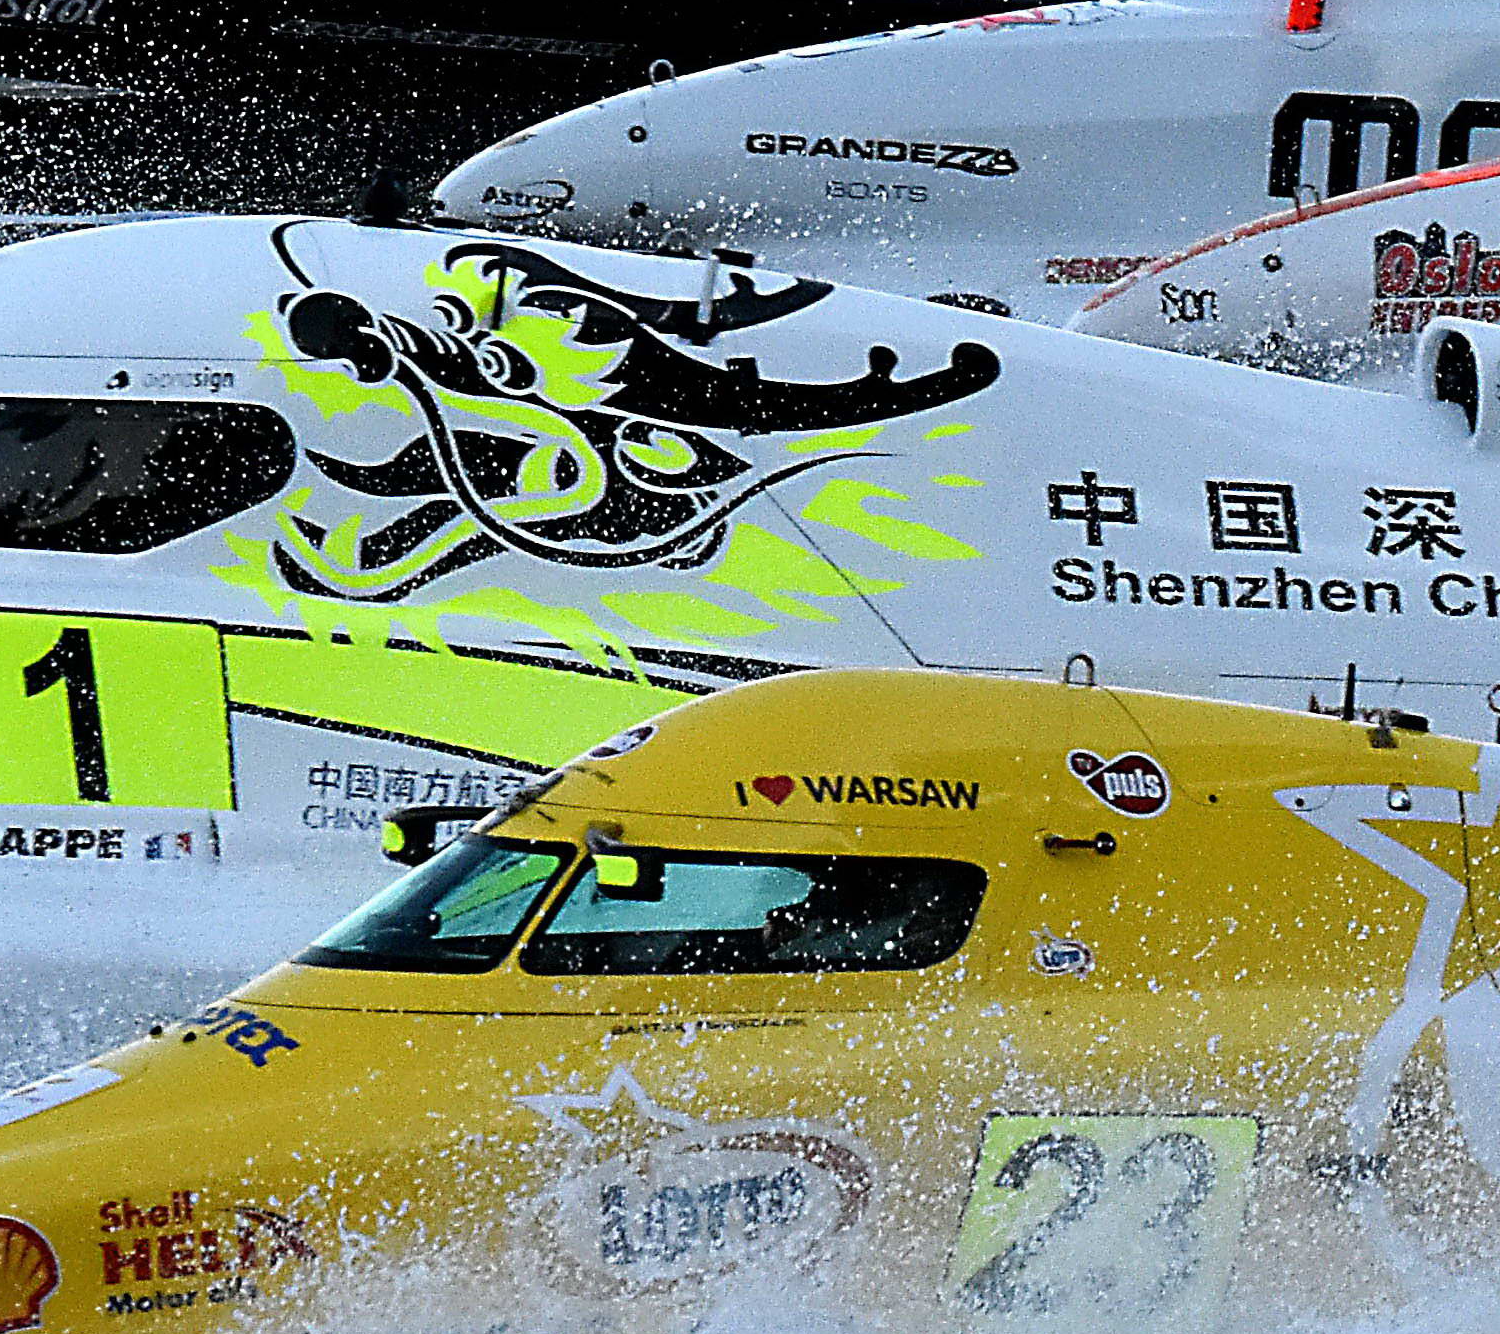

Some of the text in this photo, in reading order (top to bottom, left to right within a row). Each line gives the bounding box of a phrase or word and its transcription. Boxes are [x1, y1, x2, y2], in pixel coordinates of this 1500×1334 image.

[825, 181, 929, 203] BOATS
[1051, 558, 1402, 615] Shenzhen
[22, 626, 112, 804] 1
[735, 775, 981, 812] I WARSAW
[1103, 768, 1163, 801] puls
[99, 1190, 194, 1233] Shell
[598, 1166, 808, 1267] LOTTO
[106, 1287, 198, 1315] Motor
